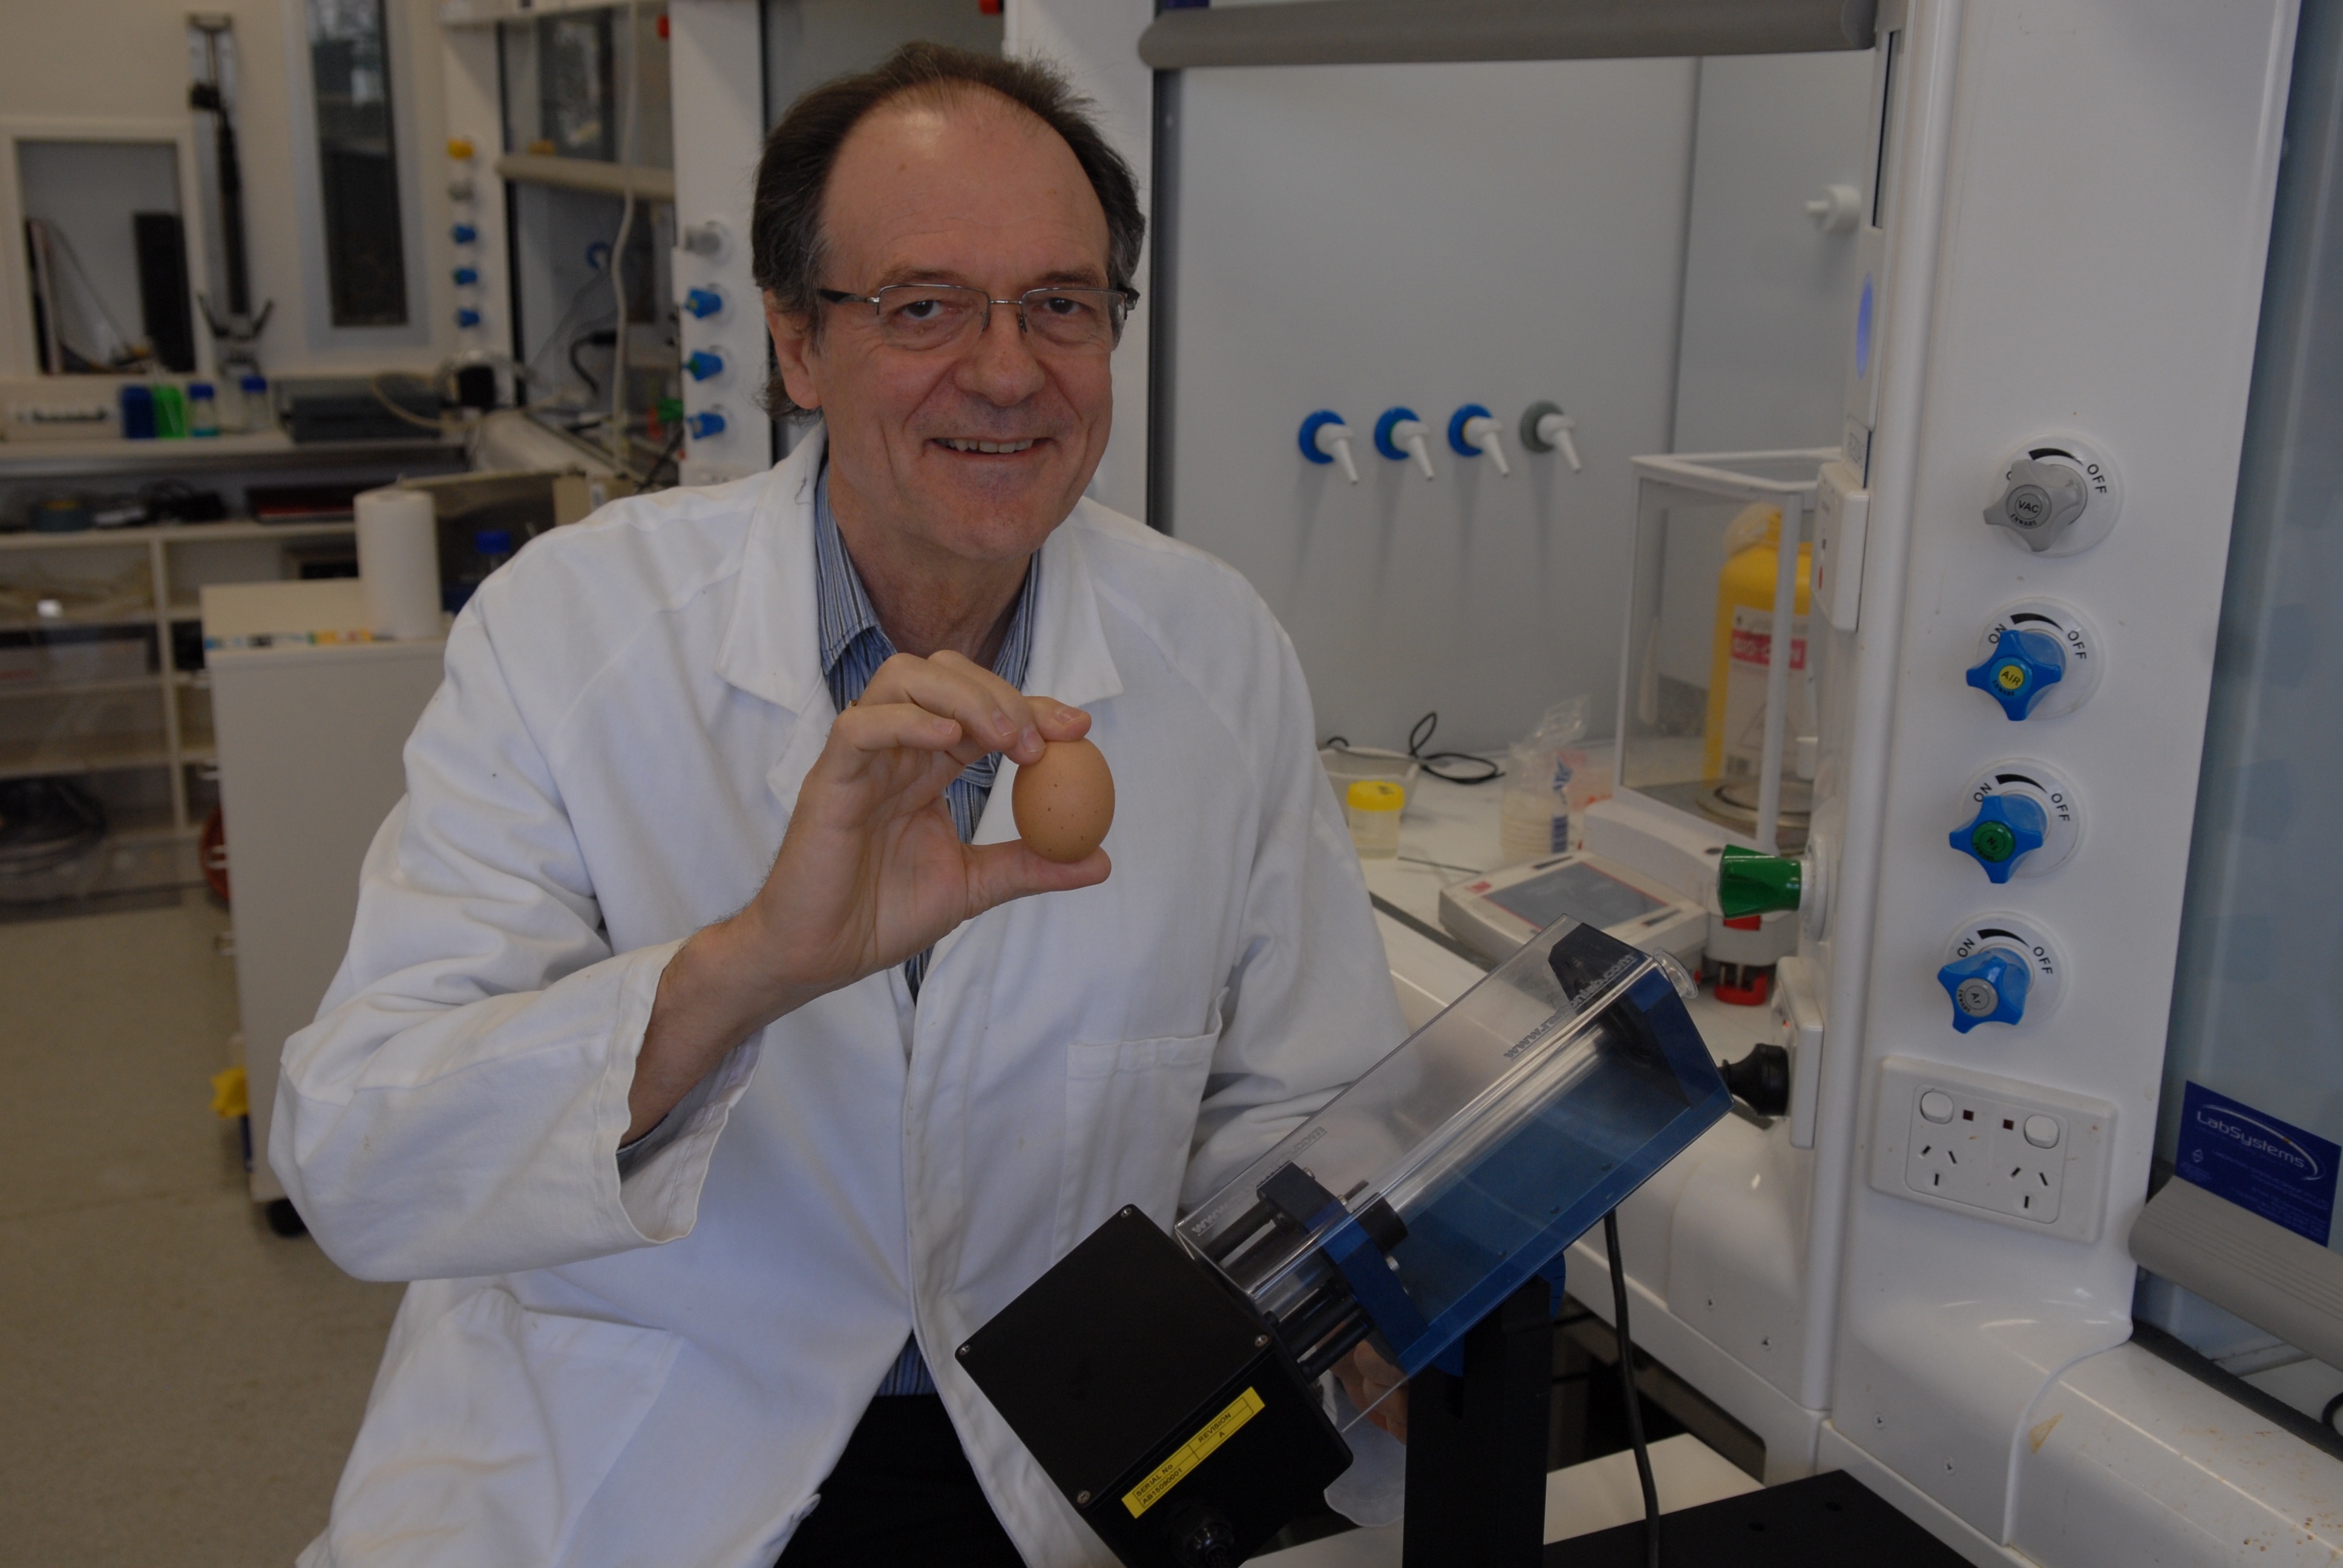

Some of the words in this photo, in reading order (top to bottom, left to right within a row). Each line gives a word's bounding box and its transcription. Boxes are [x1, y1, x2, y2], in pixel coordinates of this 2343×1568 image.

[2087, 463, 2107, 494] OFF
[2019, 500, 2039, 513] VAC
[1988, 623, 2008, 644] ON
[2068, 630, 2087, 660] OFF
[2001, 670, 2021, 686] AIR
[1973, 783, 1993, 802] ON
[2051, 793, 2070, 822] OFF
[1957, 938, 1975, 958] ON
[2033, 946, 2053, 975] OFF
[1971, 993, 1981, 1004] Ar
[2197, 1111, 2305, 1168] LabSystems
[1198, 1413, 1231, 1443] REVISION
[1136, 1475, 1162, 1497] SERIAL
[1162, 1465, 1173, 1474] No
